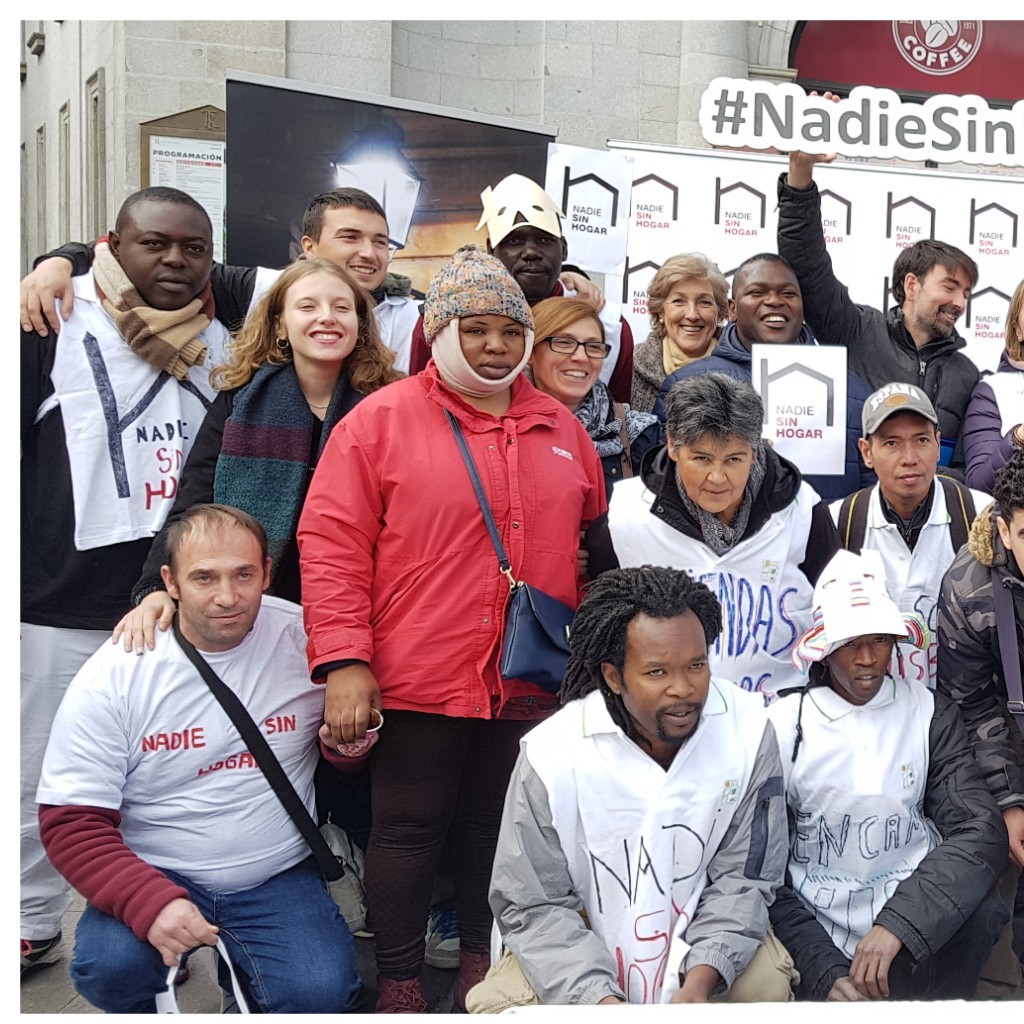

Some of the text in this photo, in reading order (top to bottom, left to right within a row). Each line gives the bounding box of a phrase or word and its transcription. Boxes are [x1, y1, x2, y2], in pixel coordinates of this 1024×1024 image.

[903, 35, 972, 68] COFFEE
[153, 150, 222, 161] PROGRAMACIÓN
[572, 205, 602, 217] NADIE
[637, 204, 664, 213] NADIE
[572, 214, 589, 224] SIN
[636, 212, 652, 220] SIN
[725, 211, 752, 220] NADIE
[571, 223, 608, 235] HOGAR
[636, 220, 670, 229] HOGAR
[724, 228, 758, 236] HOGAR
[896, 225, 922, 234] NADIE
[896, 233, 911, 241] SIN
[979, 232, 1004, 240] NADIE
[978, 247, 1010, 256] HOGAR
[975, 315, 1001, 324] NADIE
[975, 323, 990, 331] SIN
[776, 405, 815, 416] NADIE
[776, 417, 798, 427] SIN
[776, 428, 823, 439] HOGAR
[141, 714, 297, 752] NADIE SIN
